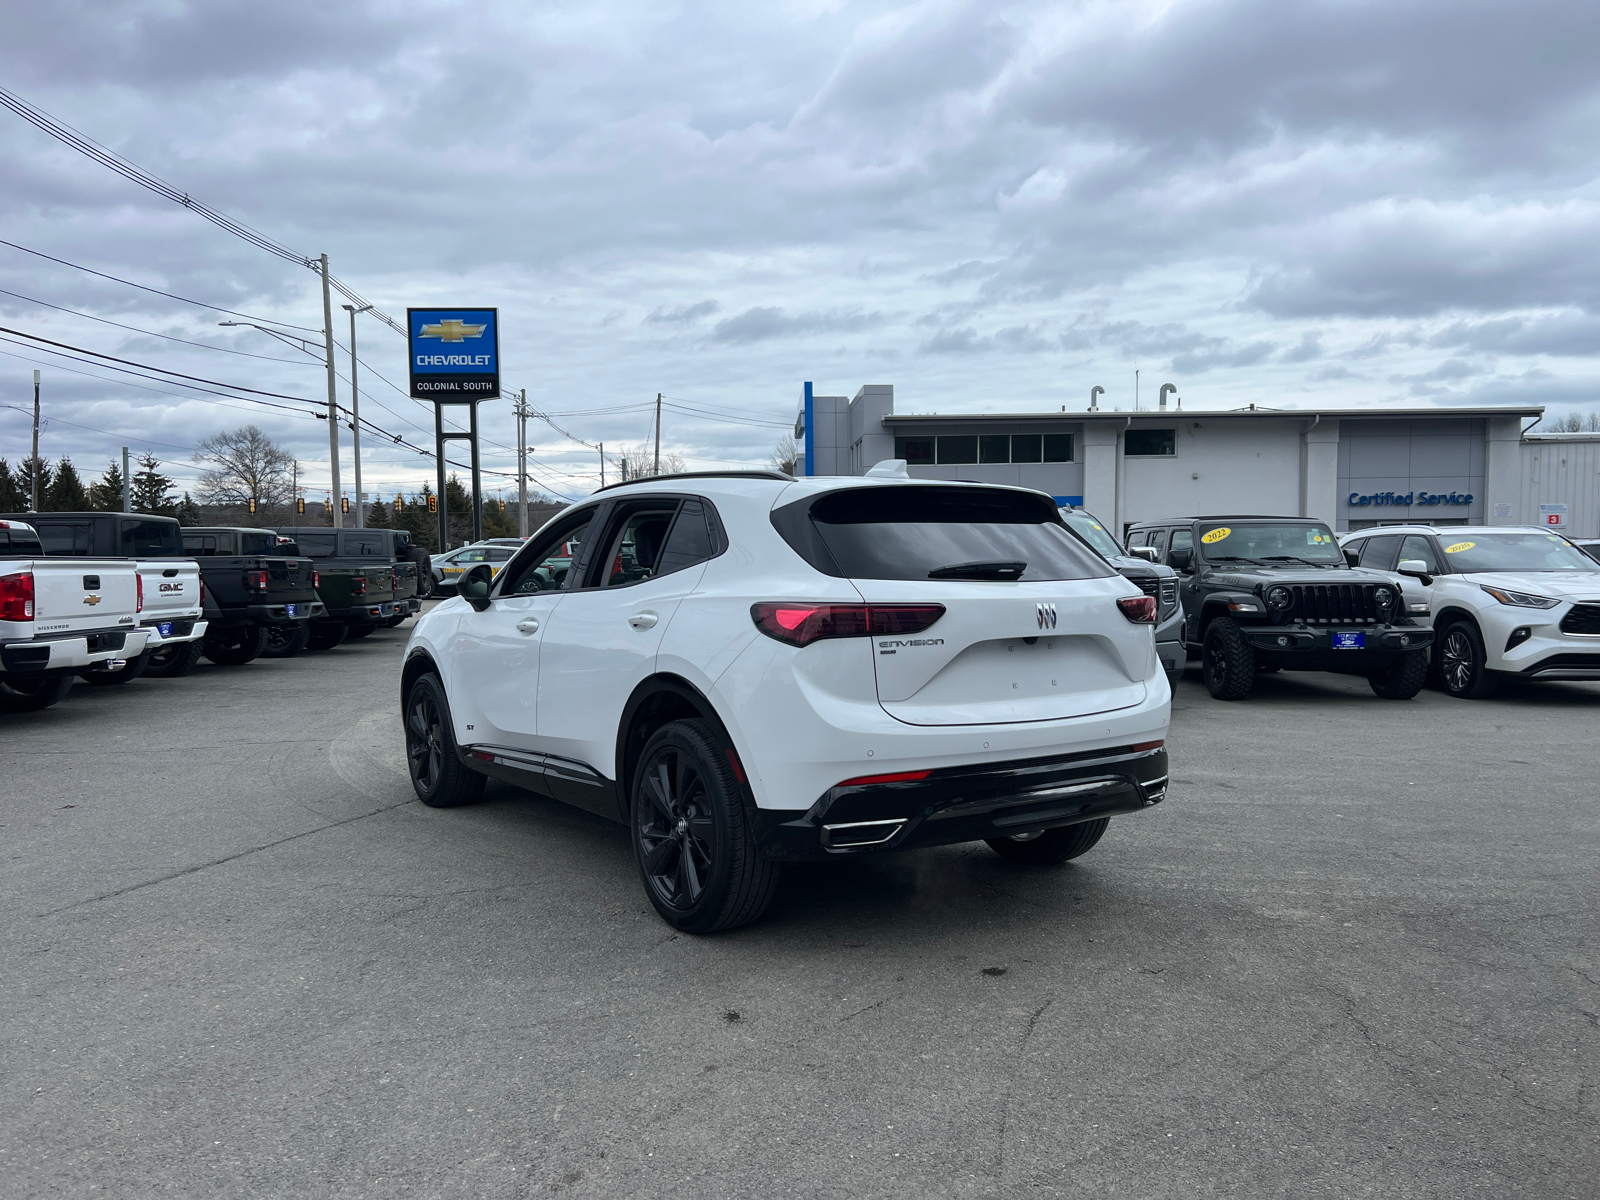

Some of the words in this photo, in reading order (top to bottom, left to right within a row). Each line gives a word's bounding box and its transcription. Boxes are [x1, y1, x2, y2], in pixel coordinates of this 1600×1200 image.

[416, 355, 491, 366] CHEVROLET
[417, 382, 461, 391] COLONIAL
[463, 382, 492, 391] SOUTH
[1349, 491, 1414, 506] Certified
[1419, 491, 1474, 505] Service
[1207, 528, 1227, 543] 2022
[1450, 542, 1470, 553] 2020
[159, 583, 184, 592] GMC
[879, 638, 945, 648] ENVISION
